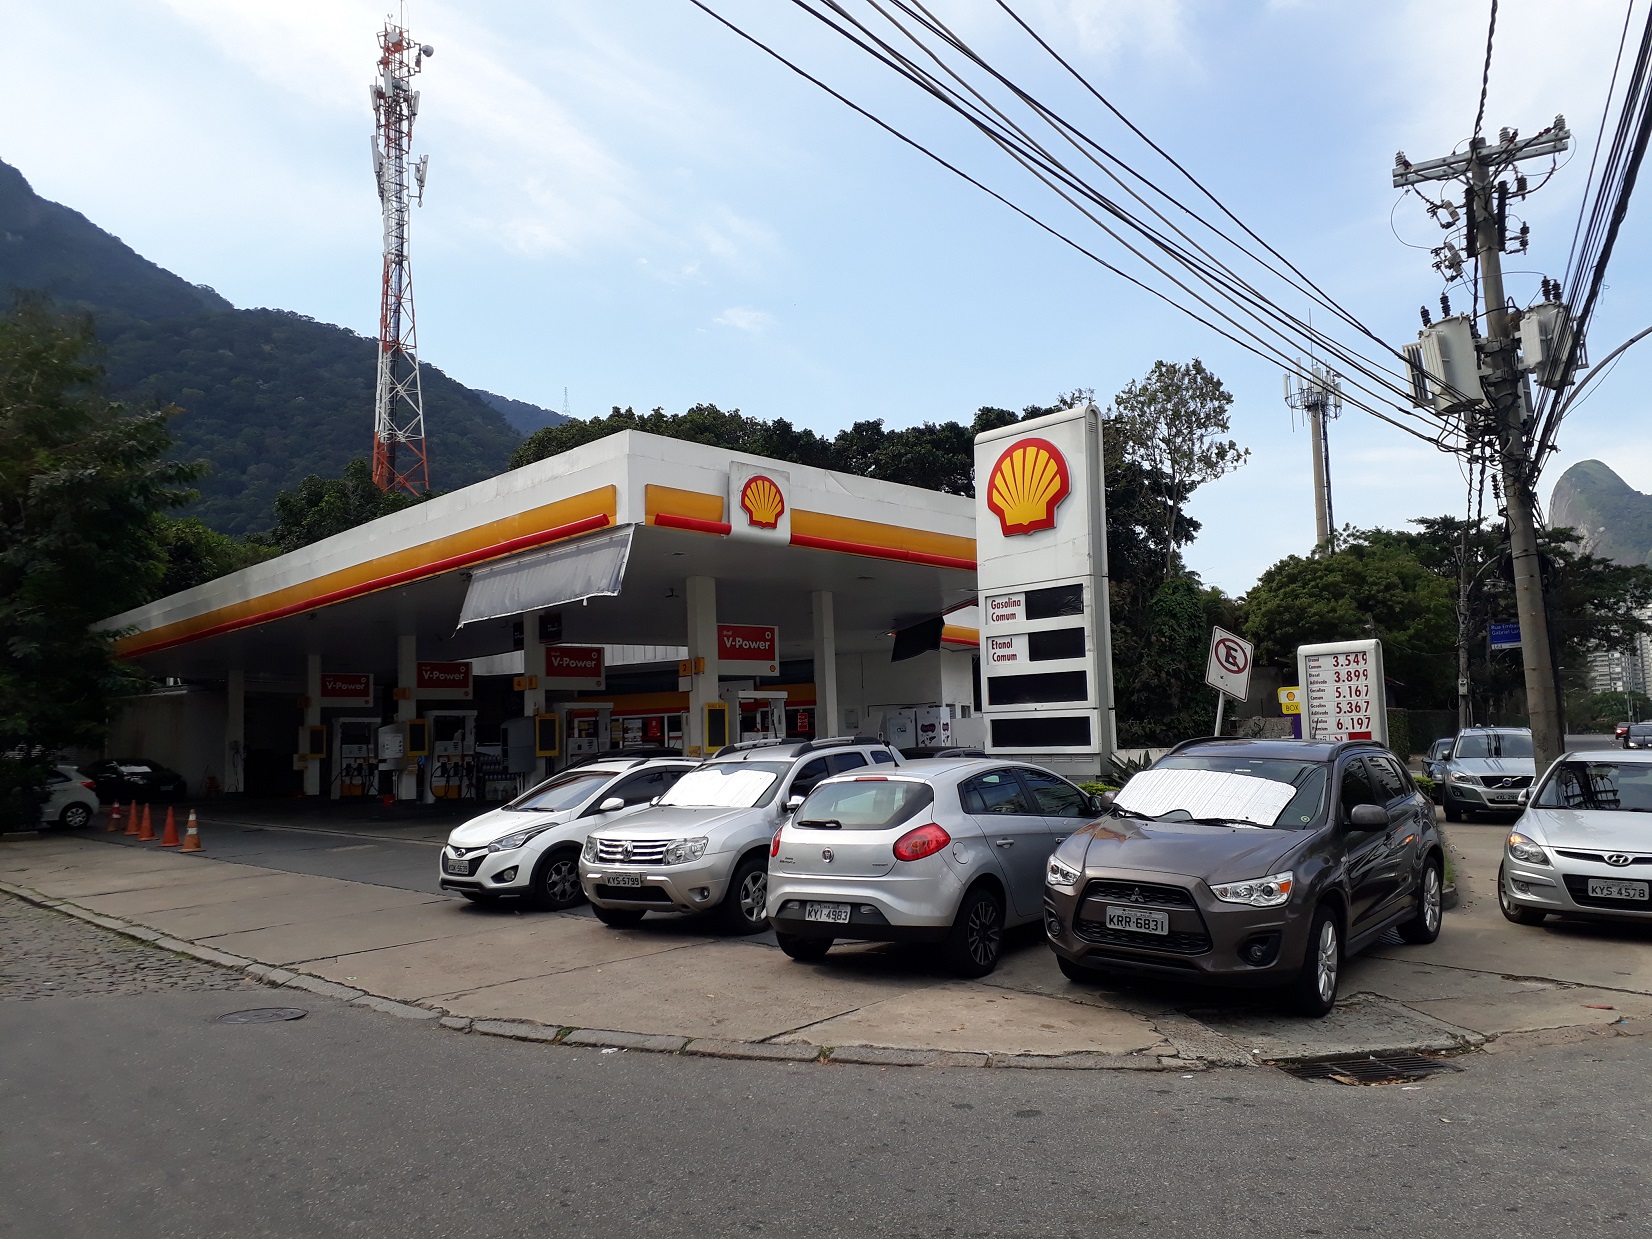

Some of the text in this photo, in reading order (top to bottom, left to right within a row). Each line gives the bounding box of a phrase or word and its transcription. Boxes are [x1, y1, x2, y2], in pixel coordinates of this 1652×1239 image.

[991, 597, 1021, 610] Gasolina
[991, 612, 1017, 622] Comum
[723, 636, 771, 650] V-Power
[991, 637, 1013, 650] Etanol
[551, 656, 597, 668] V-Power
[992, 652, 1018, 662] Comum
[1332, 652, 1367, 668] 3.549
[682, 663, 687, 672] 2
[422, 670, 464, 680] V-Power
[1334, 668, 1368, 683] 3.899
[326, 681, 365, 690] V-Power
[1335, 685, 1369, 699] 5.167
[1285, 704, 1299, 712] BOX
[1336, 701, 1370, 714] 5.367
[1336, 717, 1371, 731] 6.197
